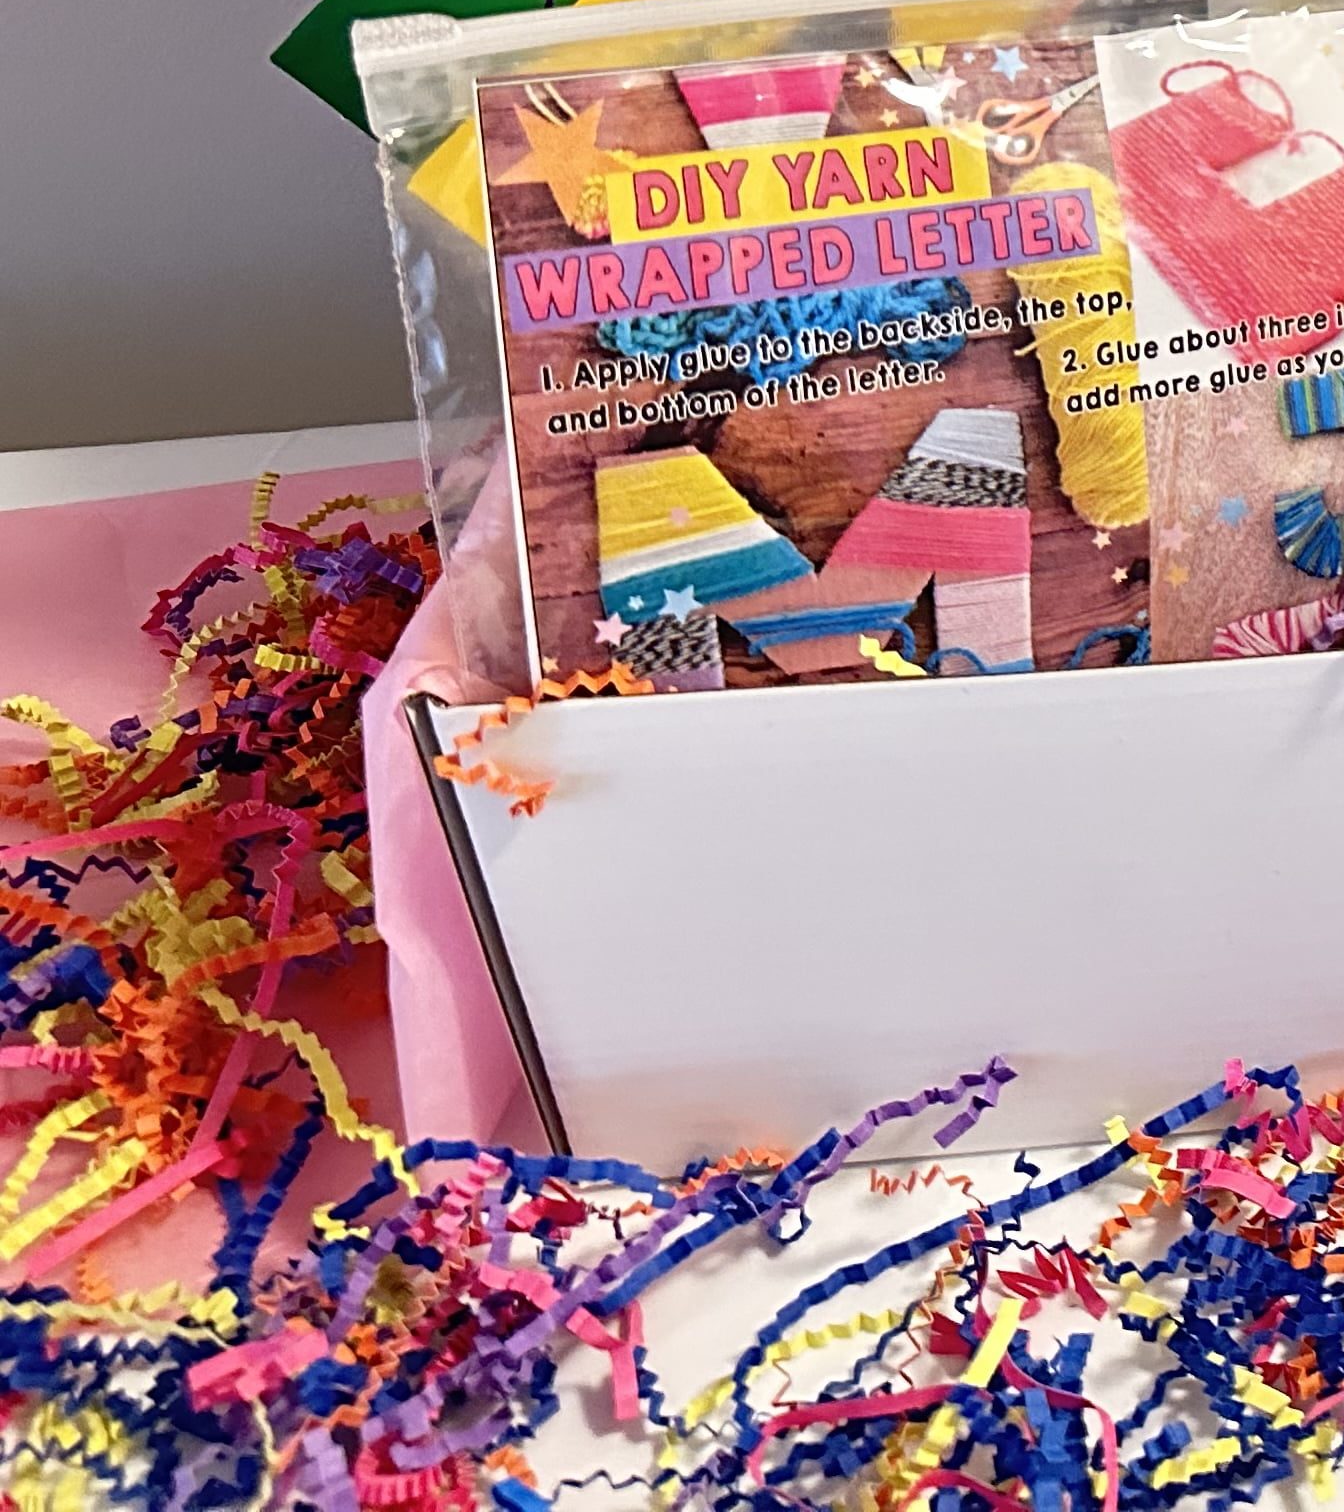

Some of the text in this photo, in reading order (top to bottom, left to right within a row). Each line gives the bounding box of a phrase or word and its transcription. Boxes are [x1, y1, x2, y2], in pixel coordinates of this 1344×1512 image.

[634, 137, 954, 230] DIY YARN
[516, 194, 1094, 320] WRAPPED LETTER
[573, 353, 669, 391] Apply
[680, 342, 749, 378] glue
[758, 336, 791, 362] to
[800, 329, 851, 357] the
[860, 307, 1011, 349] backside,
[1019, 294, 1065, 324] the
[1077, 290, 1132, 316] top,
[1062, 348, 1087, 373] 2.
[1097, 339, 1159, 366] Glue
[1169, 320, 1249, 354] about
[1257, 311, 1328, 340] three
[548, 360, 945, 434] and bottom of the letter.
[1067, 384, 1119, 413] add
[1130, 373, 1200, 402] more
[1210, 363, 1267, 393] glue
[1277, 355, 1305, 375] as
